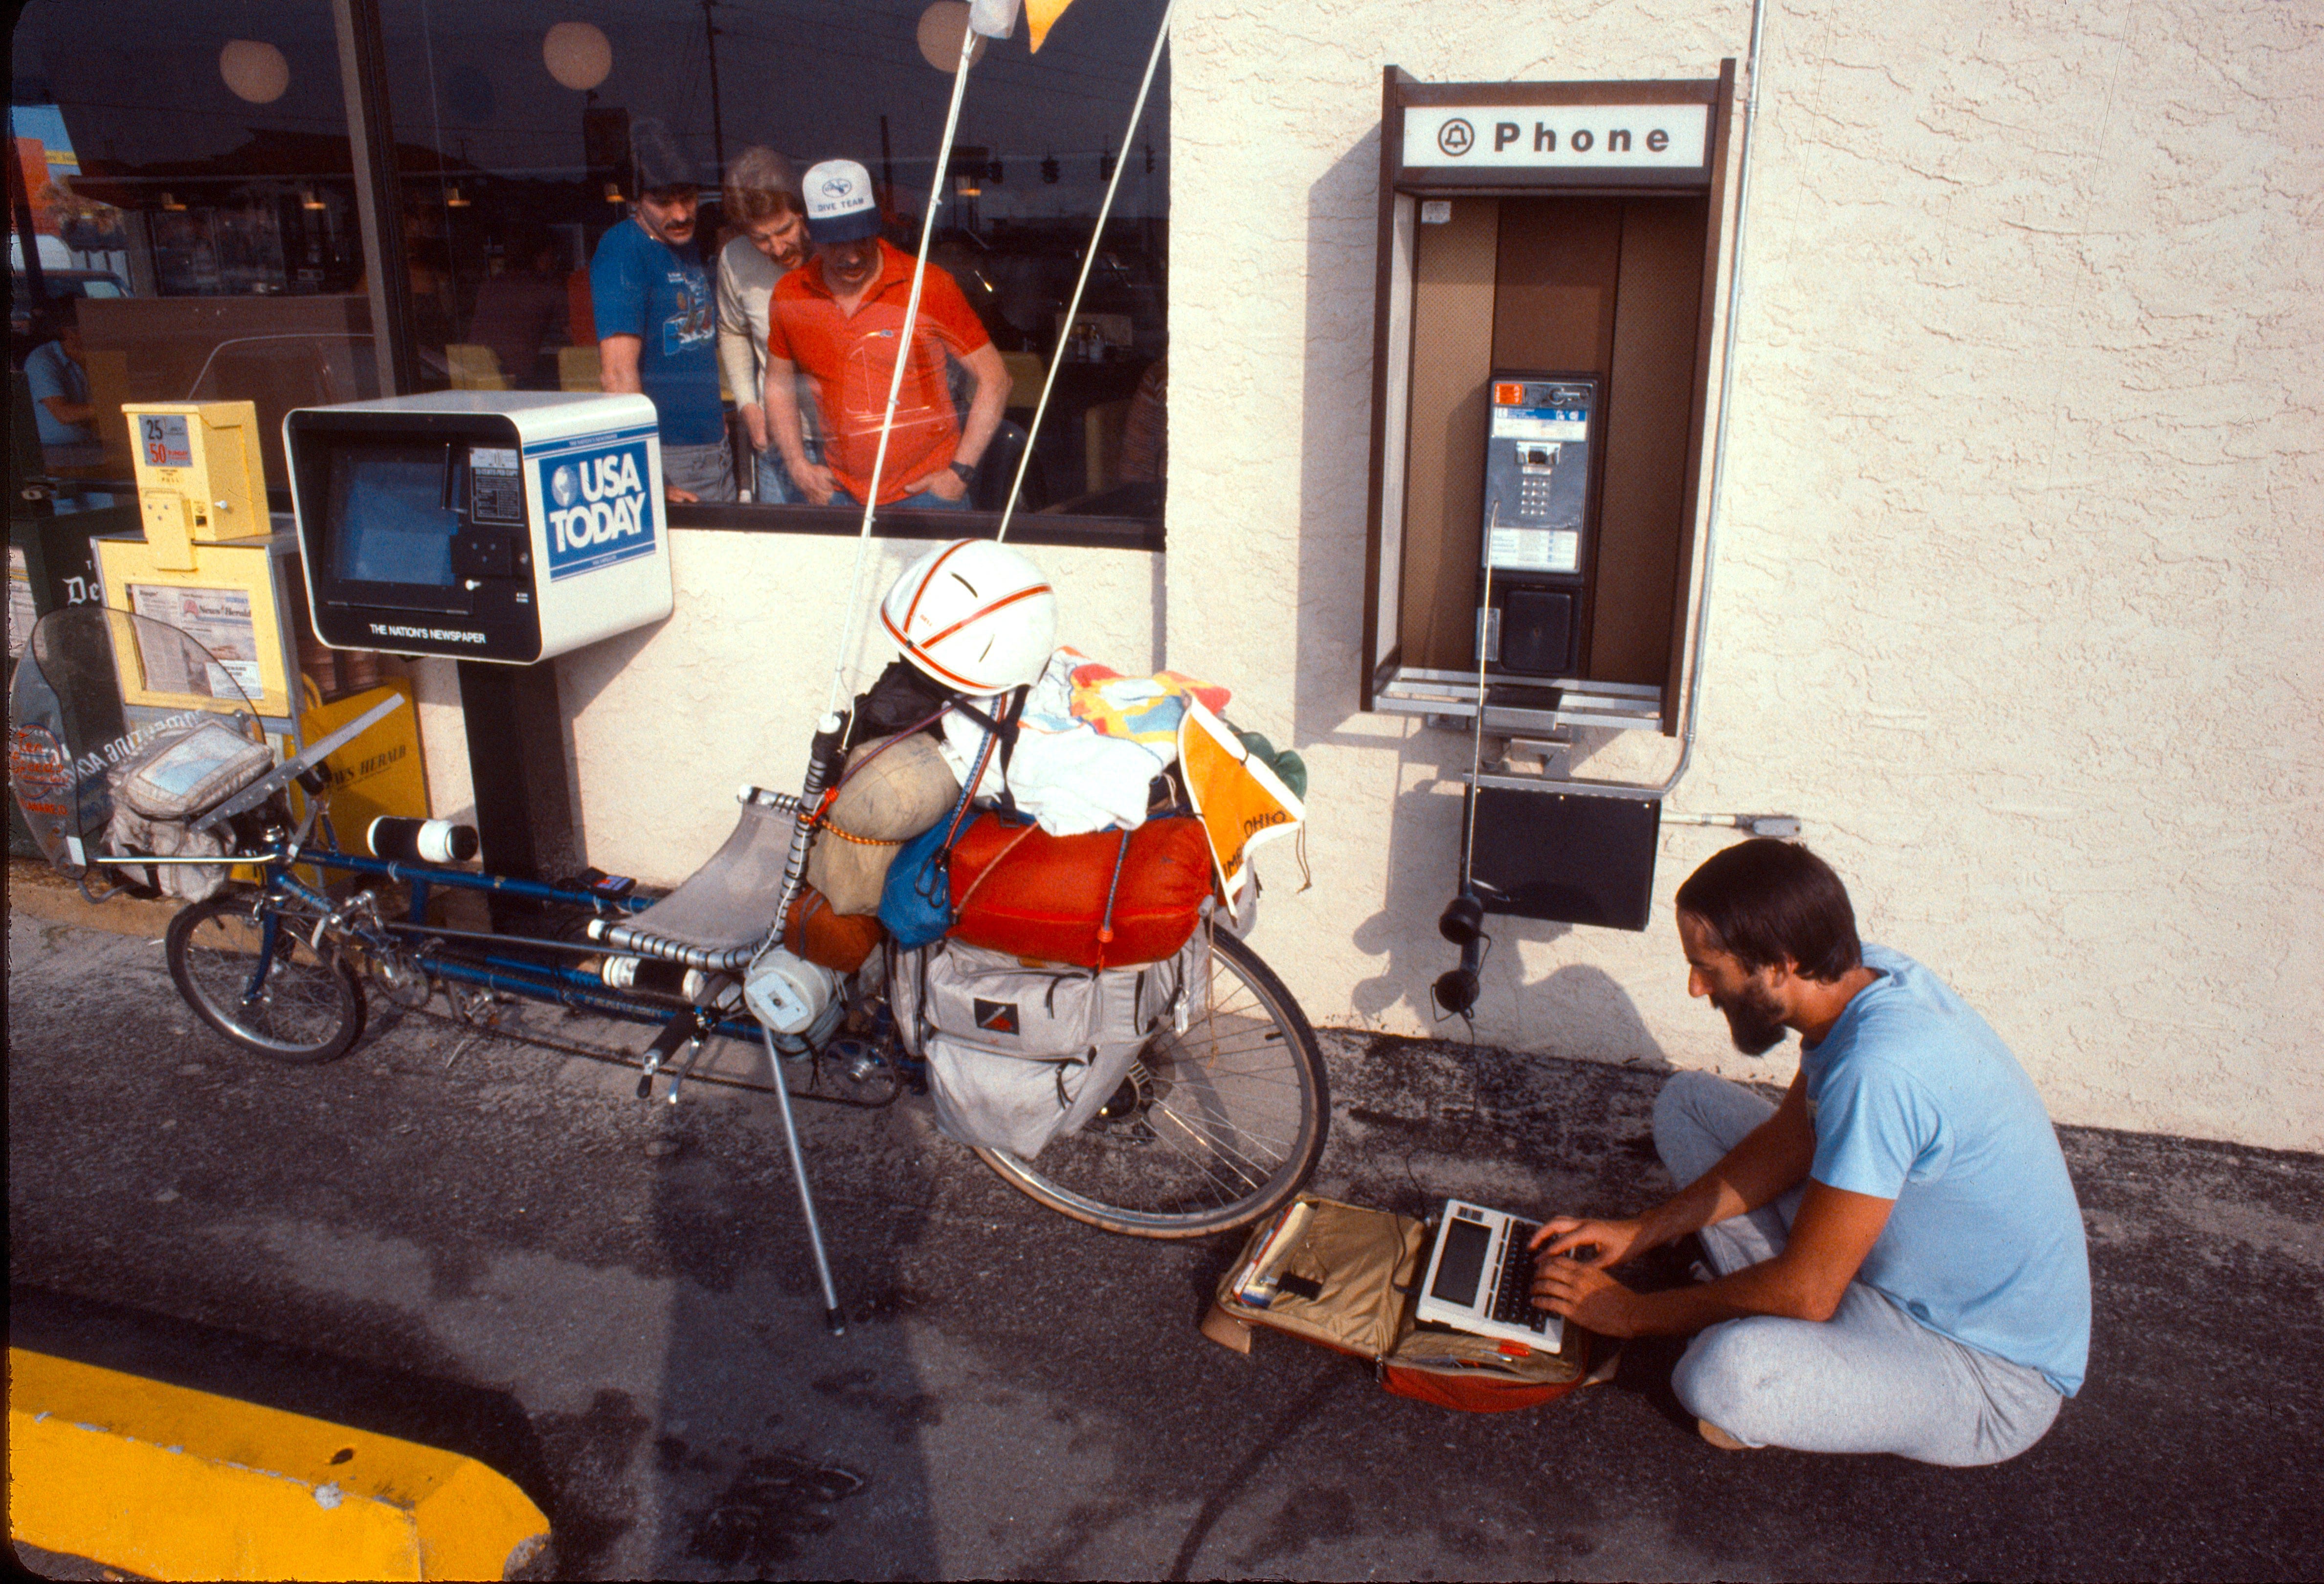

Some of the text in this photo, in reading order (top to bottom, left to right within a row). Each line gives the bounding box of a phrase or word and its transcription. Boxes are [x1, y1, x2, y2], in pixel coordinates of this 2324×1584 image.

[1495, 121, 1669, 152] Phone
[817, 197, 864, 212] DIVE TEAM
[147, 420, 163, 440] 25
[150, 443, 166, 463] 50
[579, 453, 642, 502] USA
[549, 492, 646, 553] TODAY
[369, 624, 487, 644] THE NATION'S NEWSPAPER
[359, 744, 406, 776] HERALD
[1244, 810, 1286, 838] OHIO
